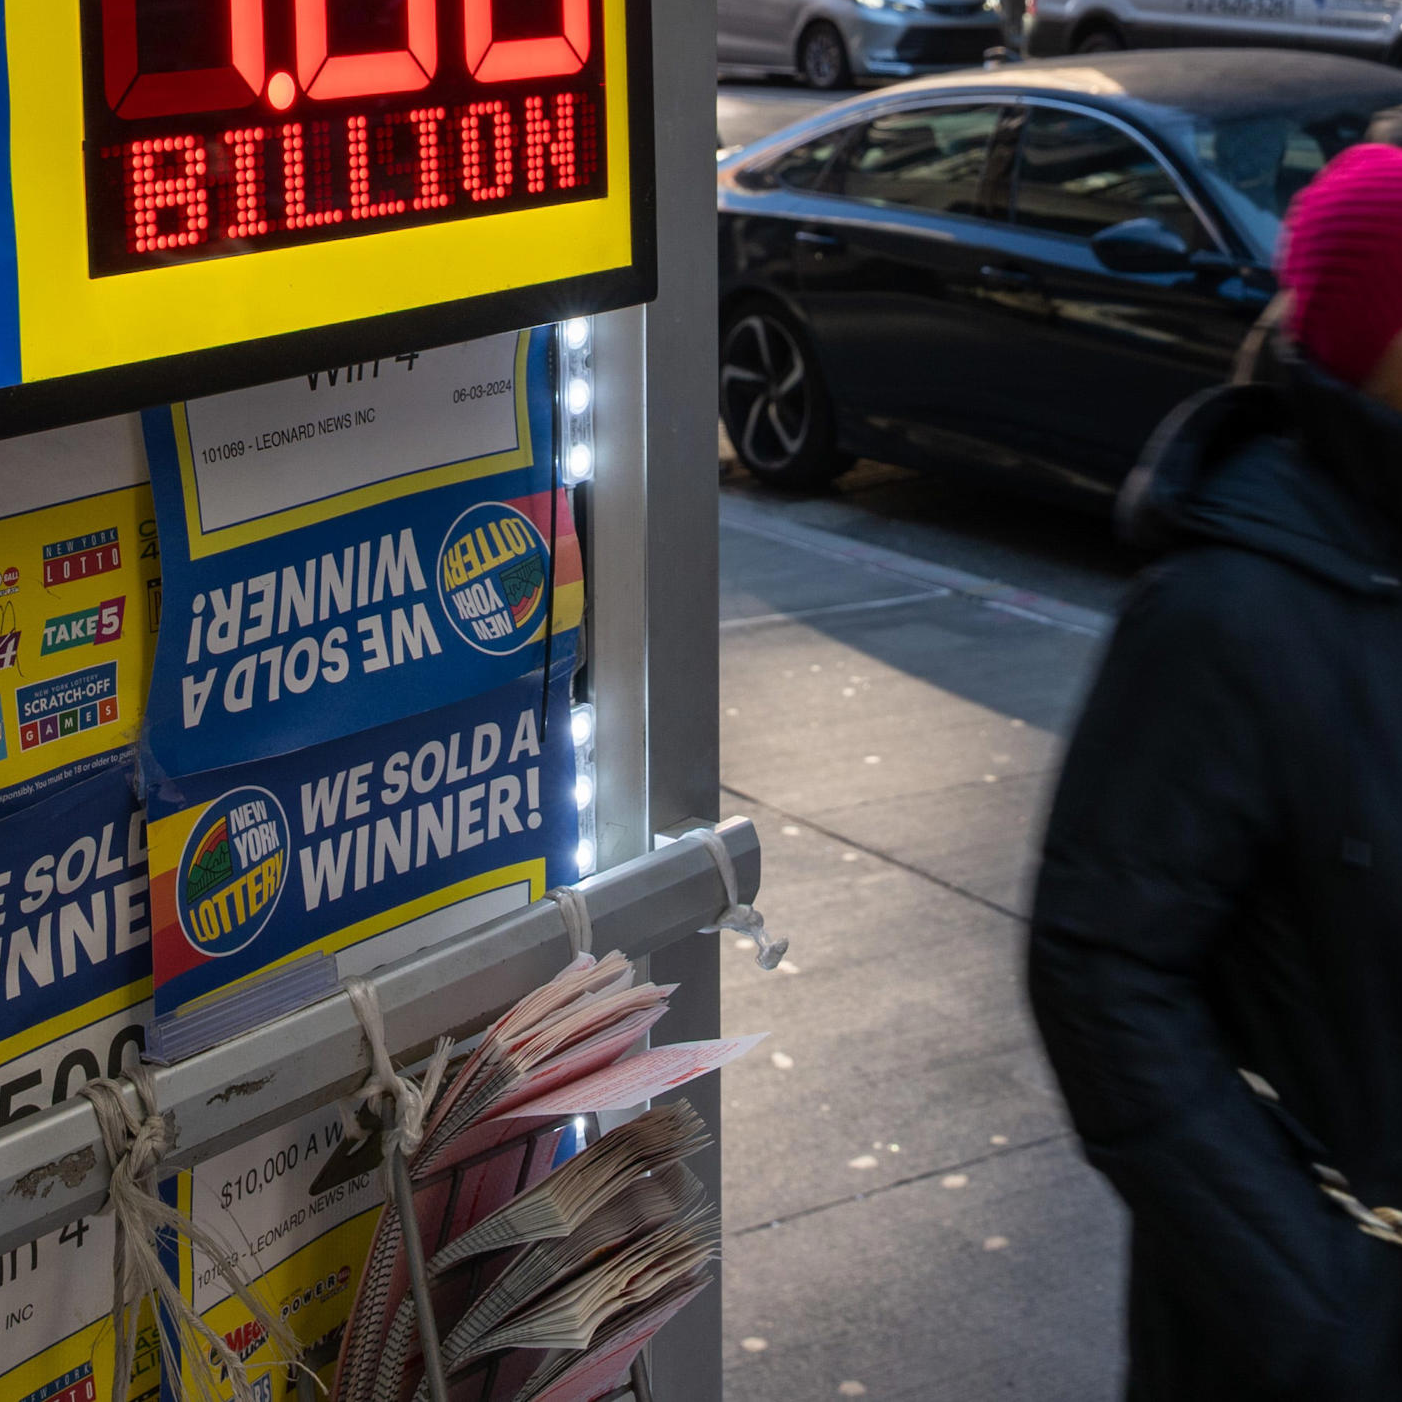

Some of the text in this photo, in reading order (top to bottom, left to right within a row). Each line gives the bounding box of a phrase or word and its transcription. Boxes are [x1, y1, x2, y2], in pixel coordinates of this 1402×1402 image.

[128, 91, 578, 256] BILLION
[452, 379, 512, 405] 06-03-2024
[201, 407, 377, 466] 101069 LEONARD NEWS INC
[45, 529, 117, 558] NEW YORK
[47, 548, 120, 583] LOTTO
[442, 517, 537, 594] LOTTERY
[185, 528, 428, 665] WINNER!
[451, 578, 505, 620] YORK
[472, 609, 513, 642] NEW
[181, 602, 443, 730] WE SOLD A
[23, 678, 111, 718] SCRATCH-OFF
[300, 708, 542, 836] WE SOLD A
[230, 800, 268, 836] NEW
[233, 818, 280, 870] YORK
[299, 766, 544, 912] WINNER!
[188, 847, 284, 944] LOTTERY
[220, 1133, 319, 1210] $10,000 A
[250, 1172, 371, 1258] LEONARD NEWS INC
[5, 1303, 35, 1331] INC
